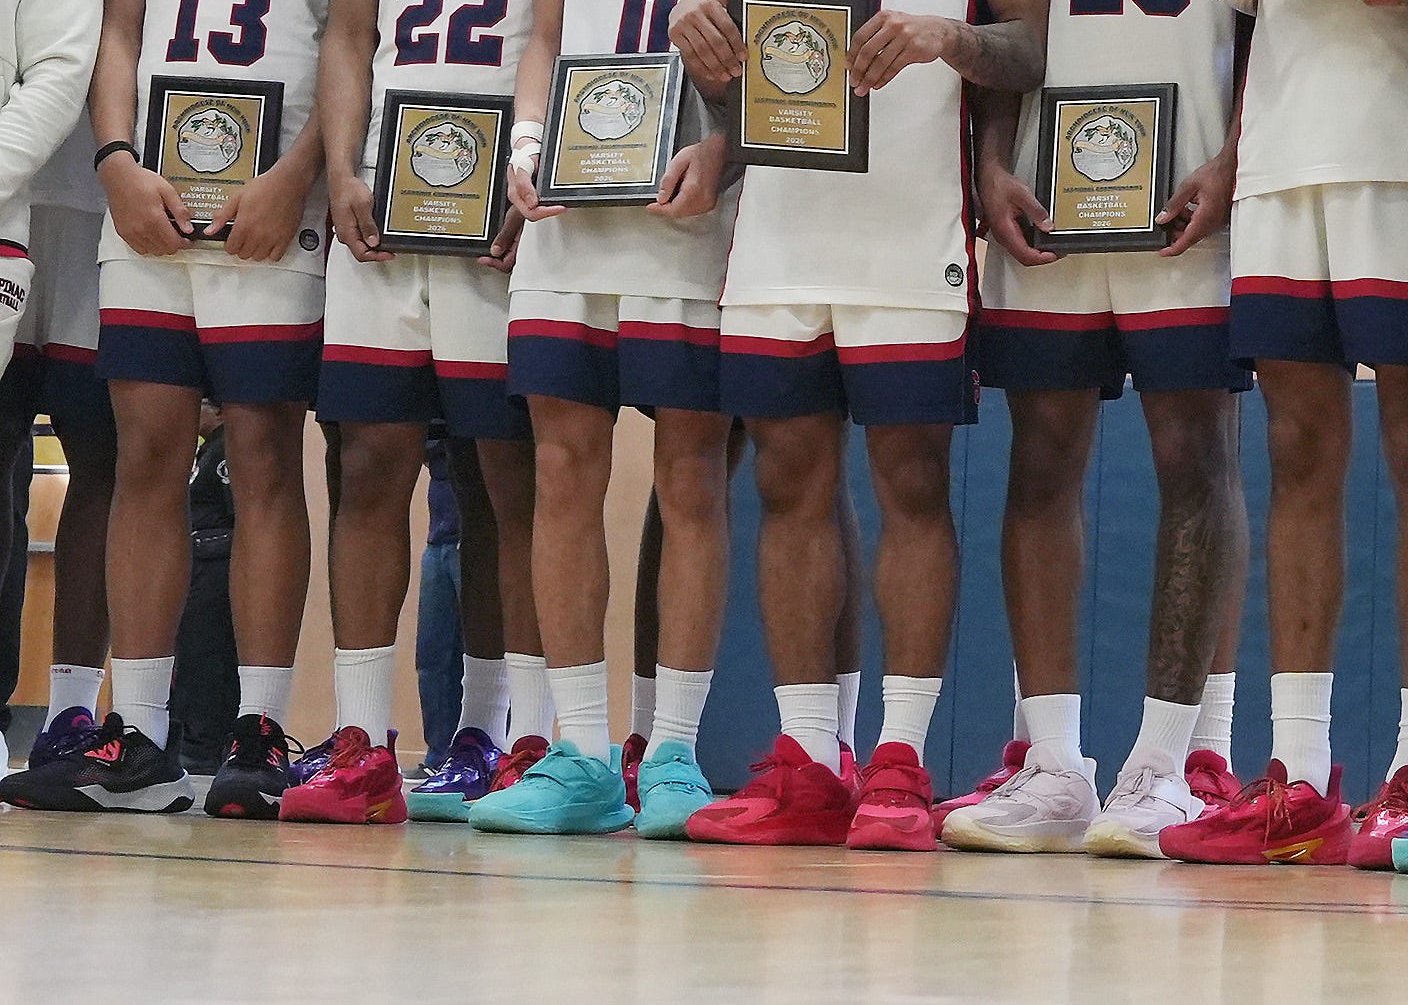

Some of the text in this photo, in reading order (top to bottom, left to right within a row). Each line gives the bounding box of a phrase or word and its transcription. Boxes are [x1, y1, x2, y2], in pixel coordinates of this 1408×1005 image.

[778, 109, 813, 117] VARSITY
[769, 116, 822, 126] BASKETBALL
[771, 126, 820, 135] CHAMPIONS
[1077, 201, 1128, 209] BASKETBALL
[413, 207, 463, 215] BASKETBALL
[414, 215, 462, 224] CHAMPIONS
